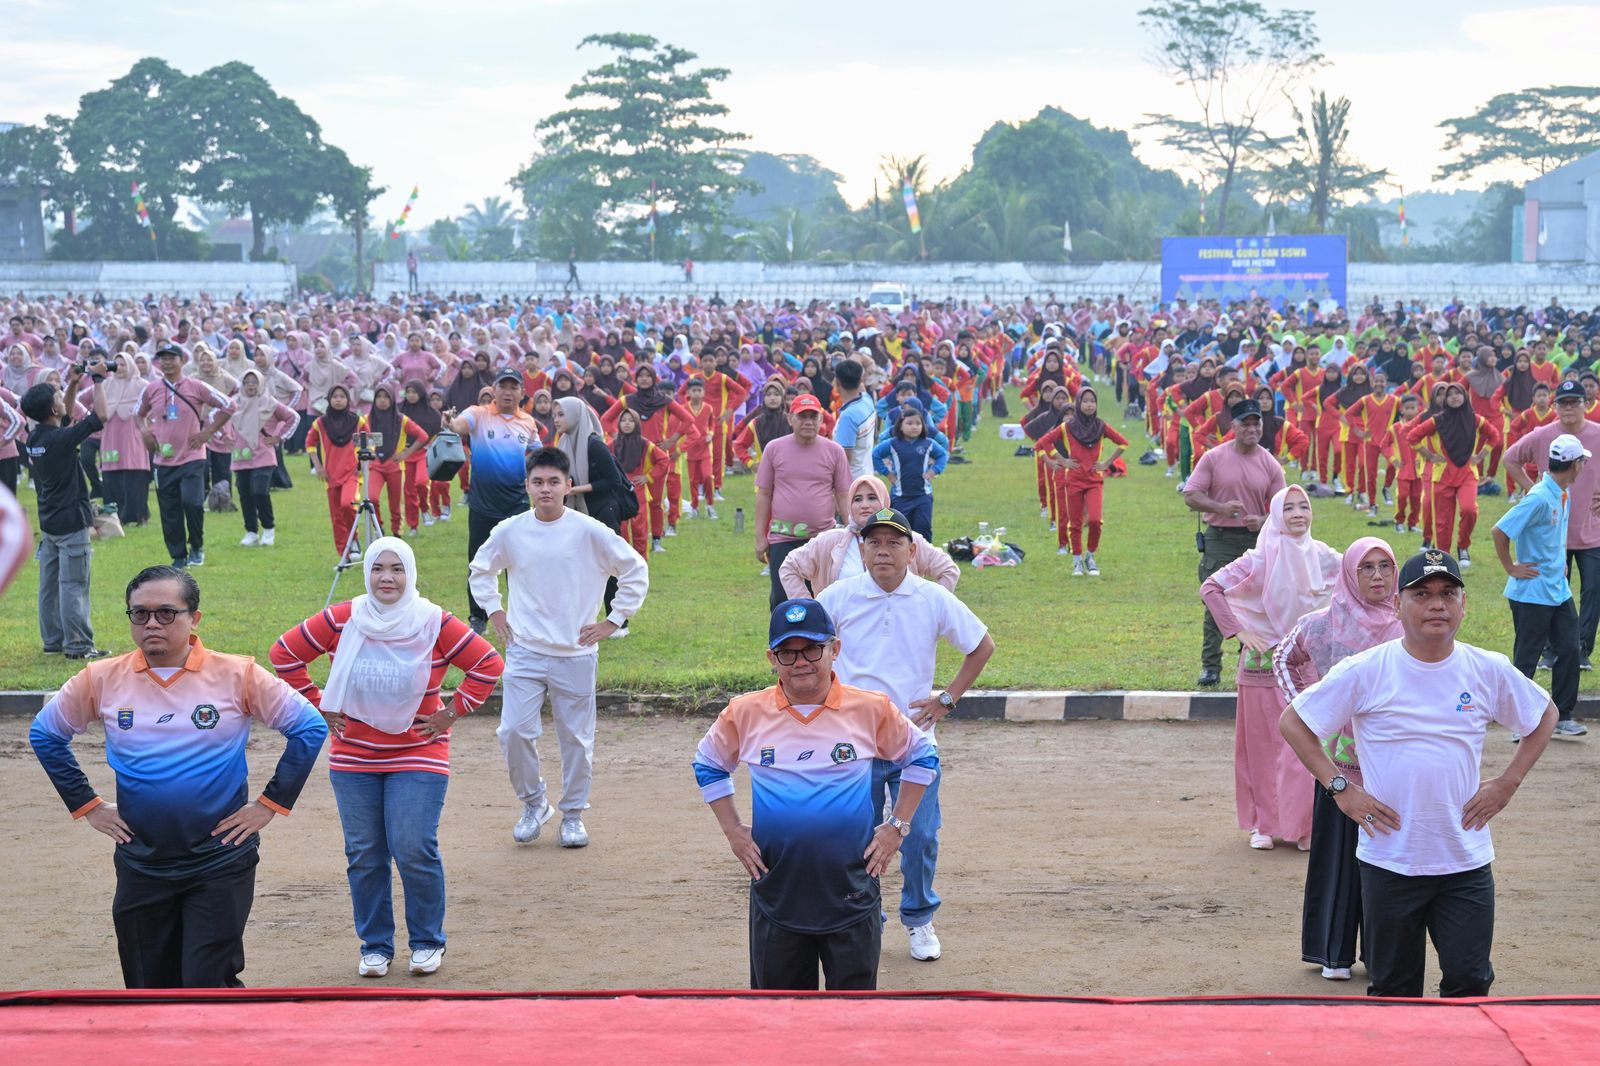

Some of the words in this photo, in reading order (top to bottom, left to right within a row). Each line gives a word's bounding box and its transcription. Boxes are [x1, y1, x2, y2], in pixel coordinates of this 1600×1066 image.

[1198, 249, 1234, 259] FESTIVAL
[1236, 249, 1259, 258] GURU
[1261, 248, 1279, 257] DAN
[1281, 248, 1307, 257] SISWA
[1232, 259, 1251, 267] KOTA
[1251, 259, 1276, 267] METRO
[356, 675, 400, 693] NETIZEN
